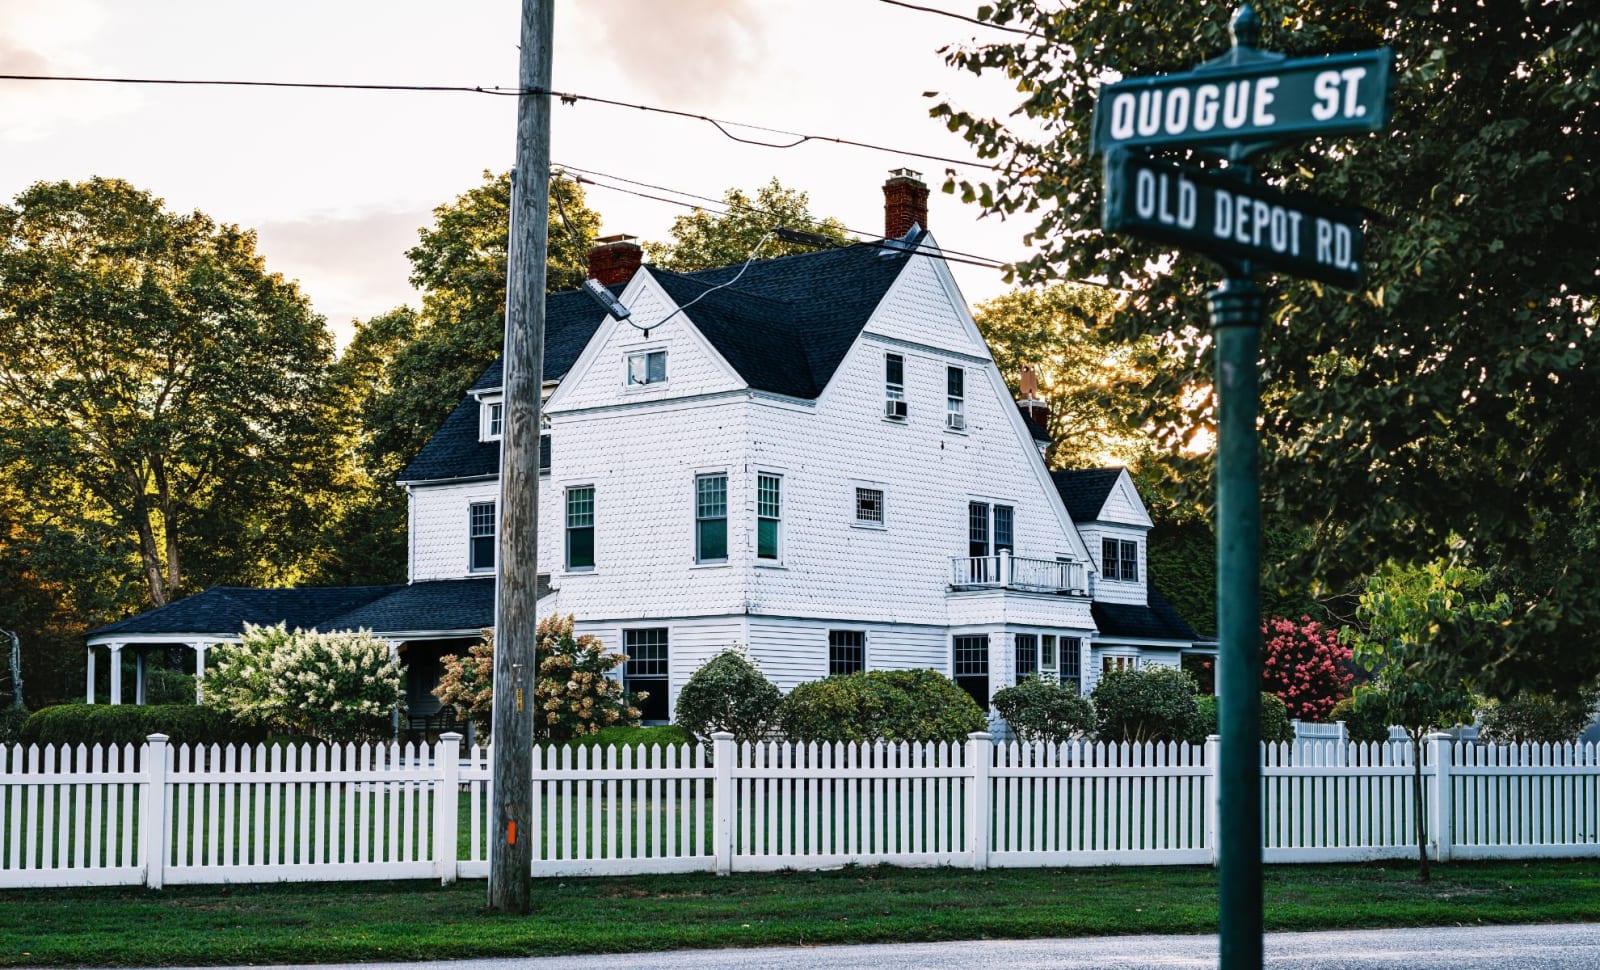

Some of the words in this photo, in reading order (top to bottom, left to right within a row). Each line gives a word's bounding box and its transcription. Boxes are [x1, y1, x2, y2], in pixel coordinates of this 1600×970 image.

[1111, 77, 1279, 139] QUOGUE
[1312, 67, 1366, 120] ST.
[1136, 169, 1197, 229] OLD
[1214, 190, 1302, 256] DEPOT
[1315, 219, 1358, 271] RD.
